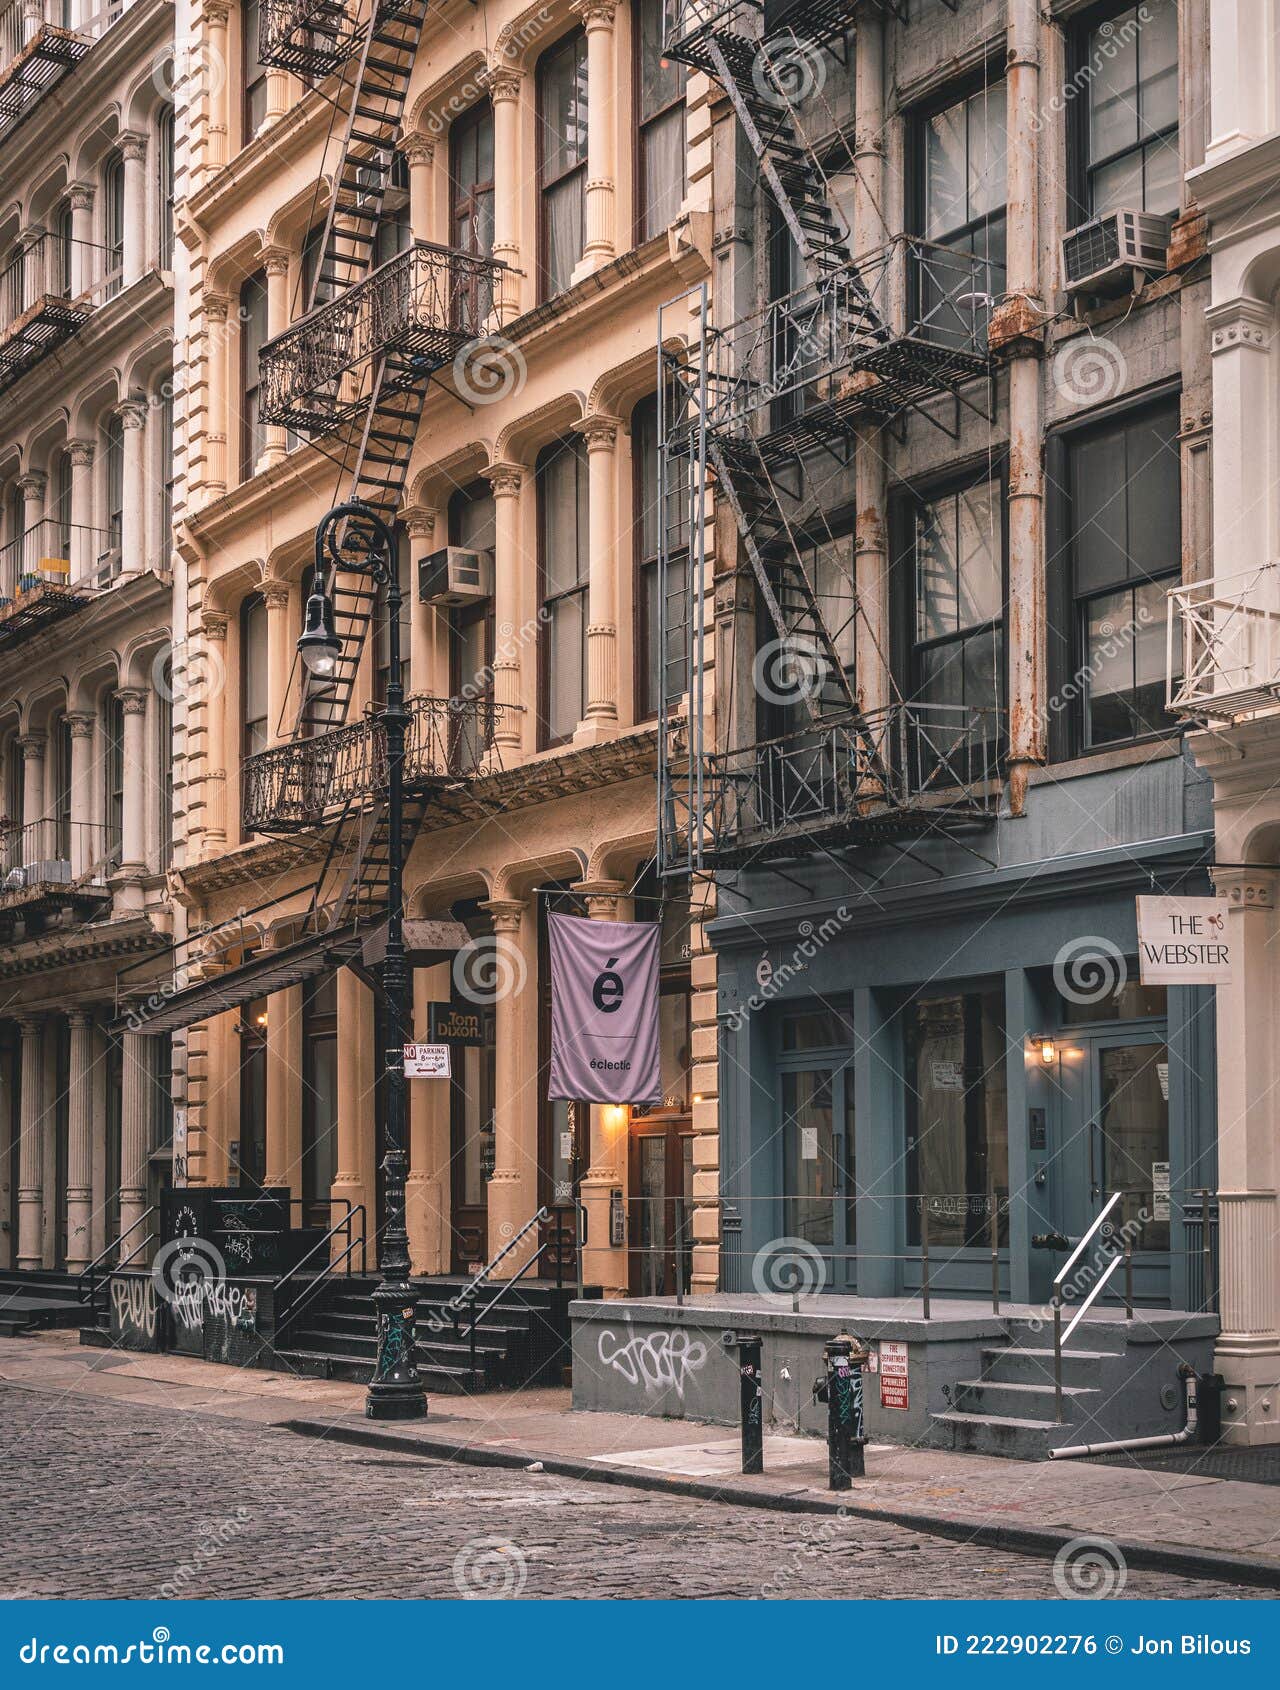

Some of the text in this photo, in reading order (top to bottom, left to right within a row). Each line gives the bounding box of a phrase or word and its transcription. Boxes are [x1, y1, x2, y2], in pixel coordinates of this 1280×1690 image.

[1168, 915, 1203, 935] THE
[1141, 941, 1229, 964] WEBSTER
[757, 950, 773, 987] é
[592, 958, 624, 1013] é
[449, 1011, 478, 1026] Tom
[403, 1047, 445, 1058] NO PARKING
[590, 1058, 631, 1071] éclectic
